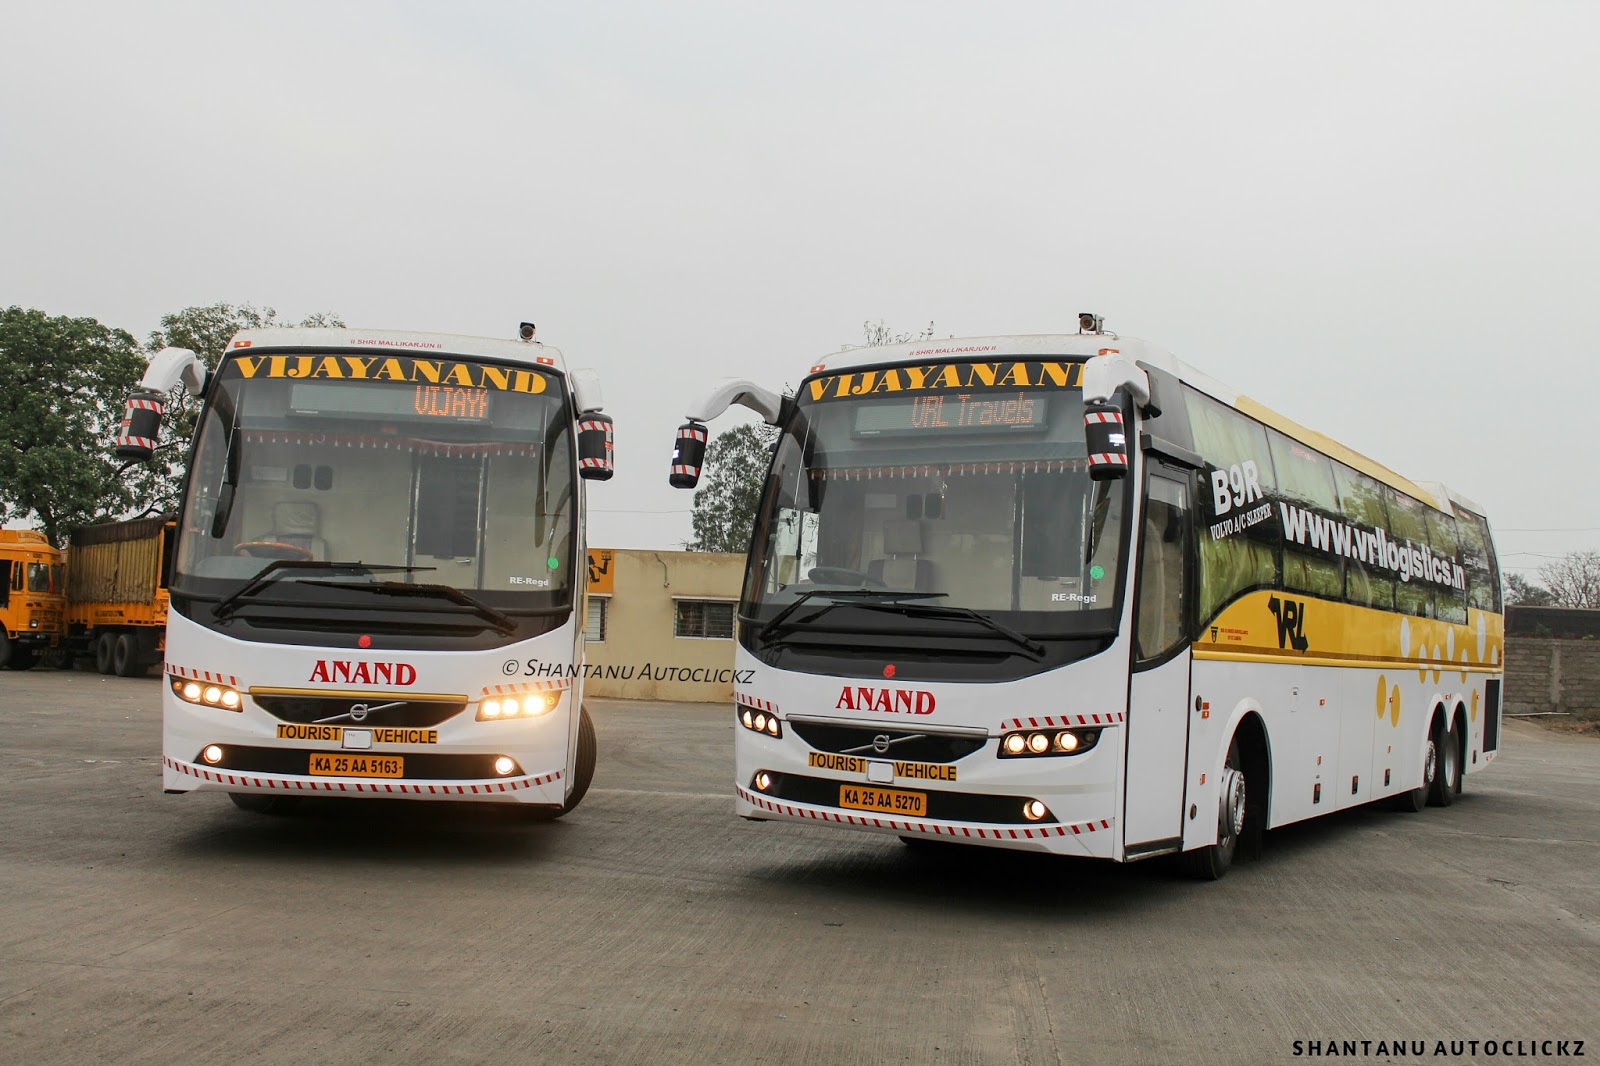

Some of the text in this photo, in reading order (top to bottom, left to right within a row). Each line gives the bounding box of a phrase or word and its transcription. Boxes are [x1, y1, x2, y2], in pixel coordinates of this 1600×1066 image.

[378, 340, 436, 349] MALLIKARJUN
[935, 346, 990, 355] MALLIKARJUN
[234, 355, 548, 395] VIJAYANAND
[957, 391, 1036, 427] Travels
[1211, 459, 1264, 516] B9R
[1210, 502, 1272, 541] VOLVO A/C SLEEPER
[509, 576, 549, 587] RE-Regd
[1051, 593, 1097, 604] RE-Regd
[1267, 593, 1309, 654] VRL
[309, 659, 417, 686] ANAND
[835, 686, 936, 715] ANAND
[277, 724, 437, 744] TOURIST VEHICLE
[315, 758, 398, 774] KA 25 AA 5163
[810, 752, 957, 782] TOURIST VEHICLE
[844, 789, 921, 812] KA 25 AA 5270
